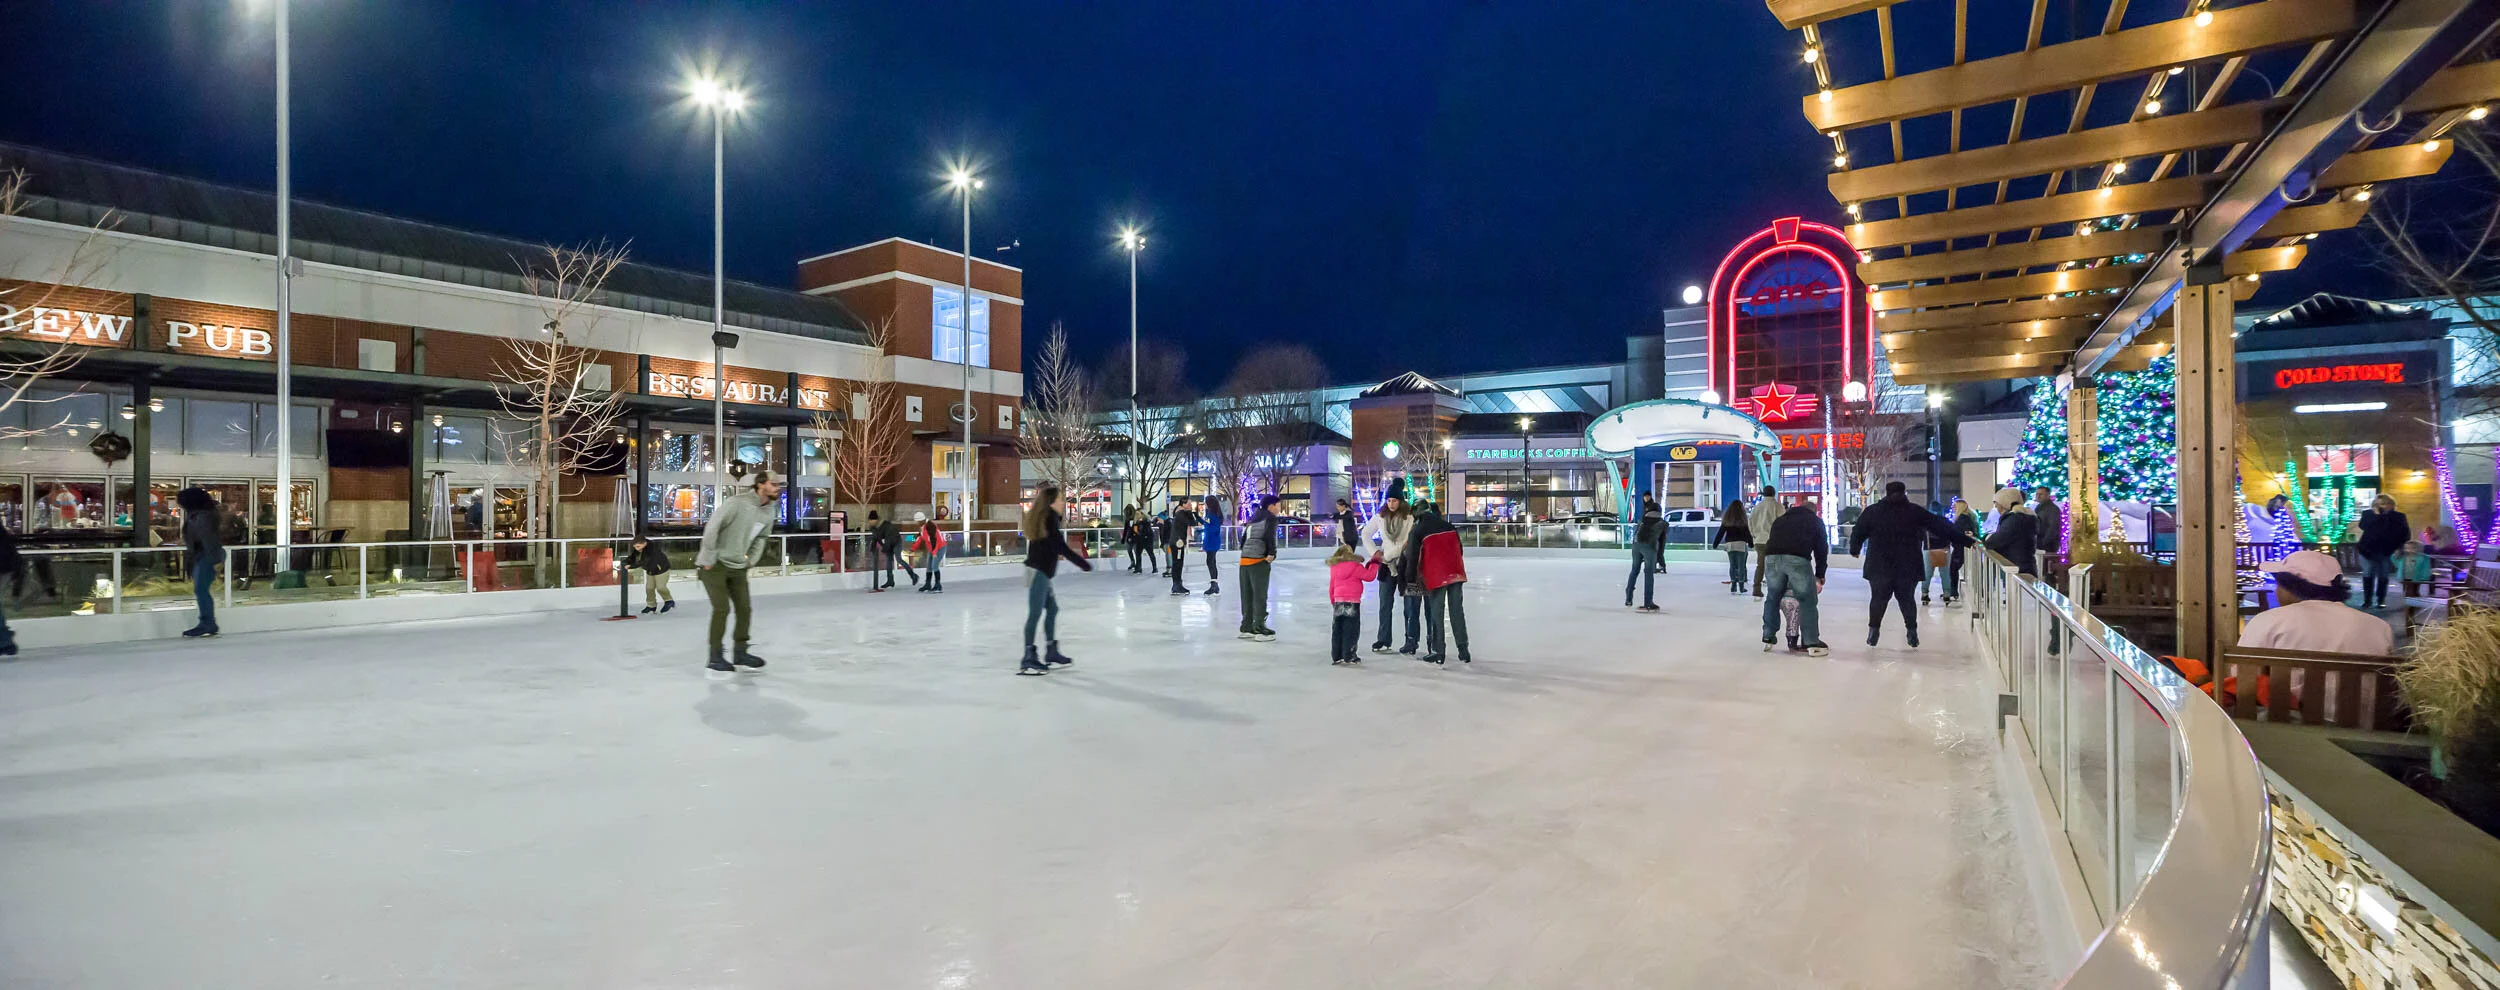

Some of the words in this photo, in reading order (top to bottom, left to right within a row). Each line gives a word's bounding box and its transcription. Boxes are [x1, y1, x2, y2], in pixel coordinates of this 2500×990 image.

[166, 320, 273, 356] PUB
[2275, 367, 2332, 389] COLD
[2332, 363, 2404, 384] STONE
[1467, 449, 1542, 459] STARBUCKS
